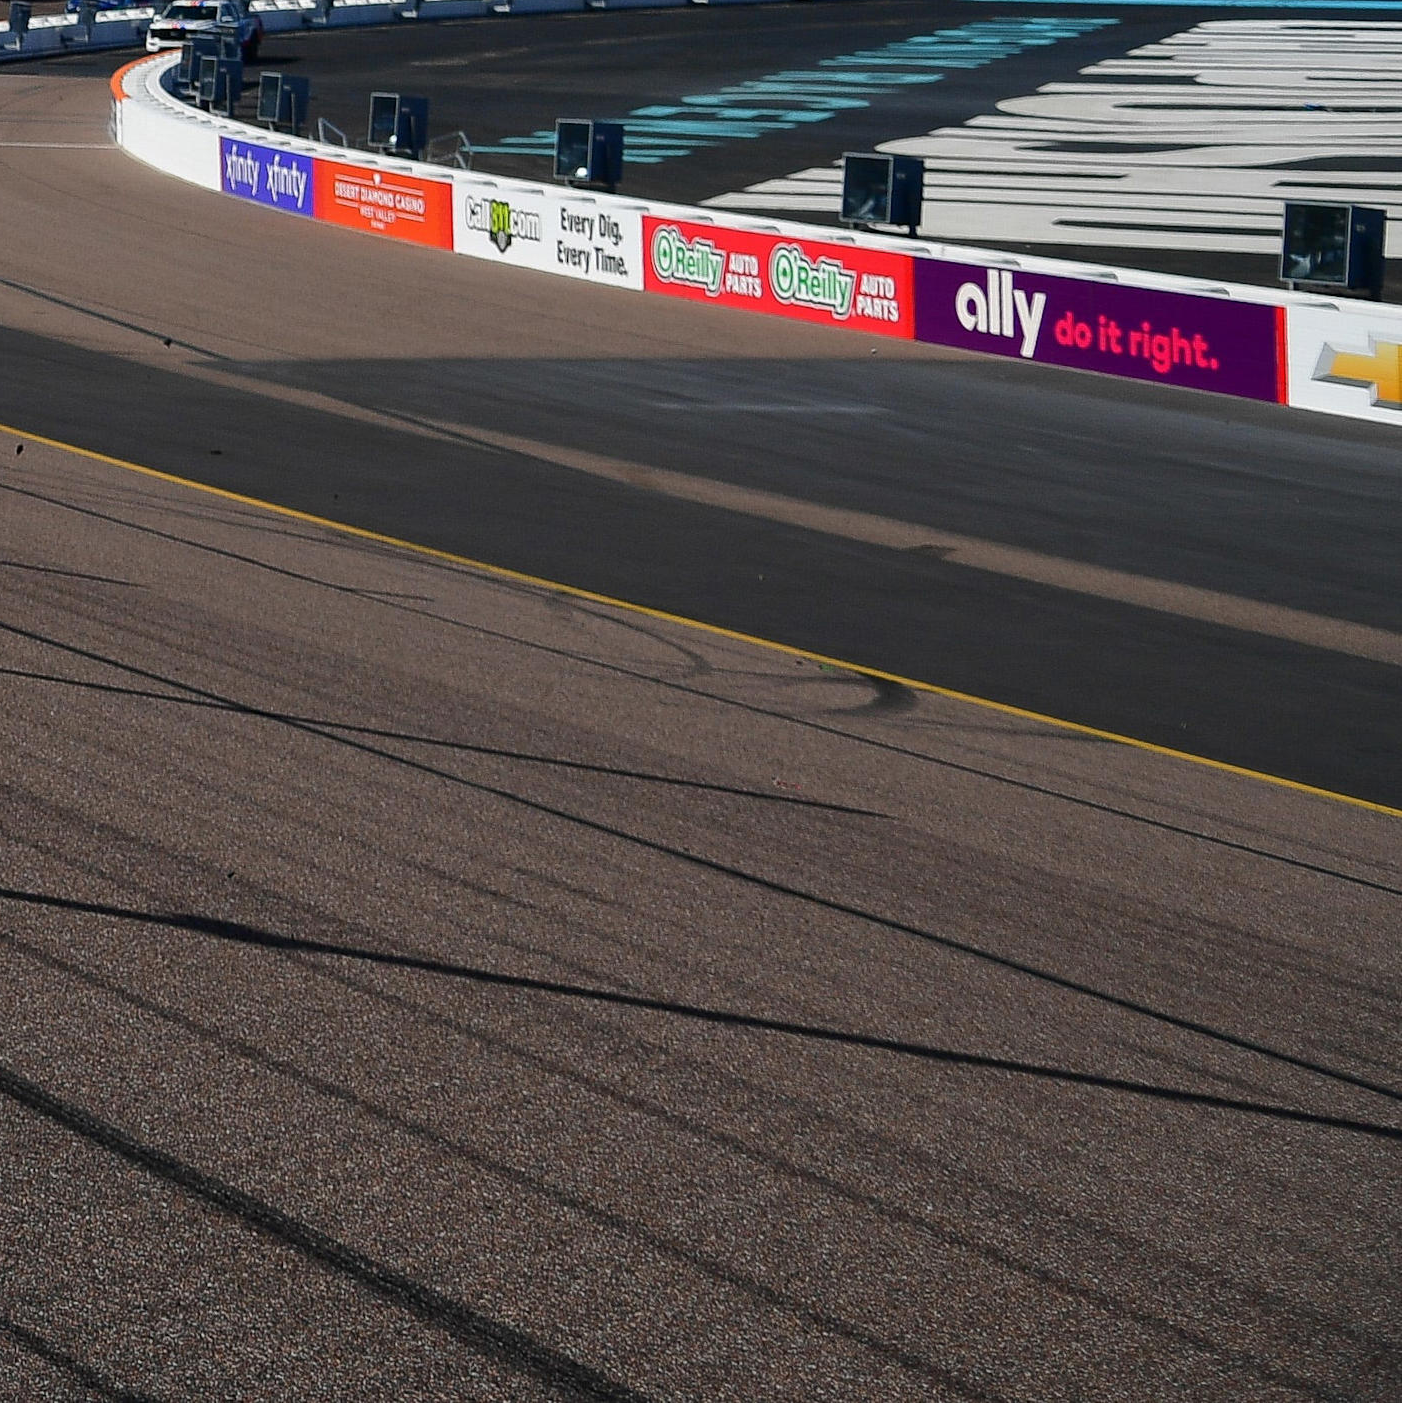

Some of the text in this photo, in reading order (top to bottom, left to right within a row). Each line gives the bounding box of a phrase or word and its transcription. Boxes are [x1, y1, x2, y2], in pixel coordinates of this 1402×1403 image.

[225, 144, 261, 197] xfinity
[266, 154, 308, 209] xfinity
[333, 180, 426, 215] DESERT DIAMOND CASINO
[358, 205, 375, 219] WEST
[559, 206, 623, 246] Every Dig.
[557, 240, 628, 277] Every Time.
[656, 228, 723, 293] O'Reilly
[728, 253, 760, 277] AUTO
[725, 272, 763, 298] PARTS
[774, 247, 855, 315] O'Reilly
[859, 273, 896, 300] AUTO
[856, 294, 900, 323] PARTS
[955, 268, 1220, 374] ally do it right.
